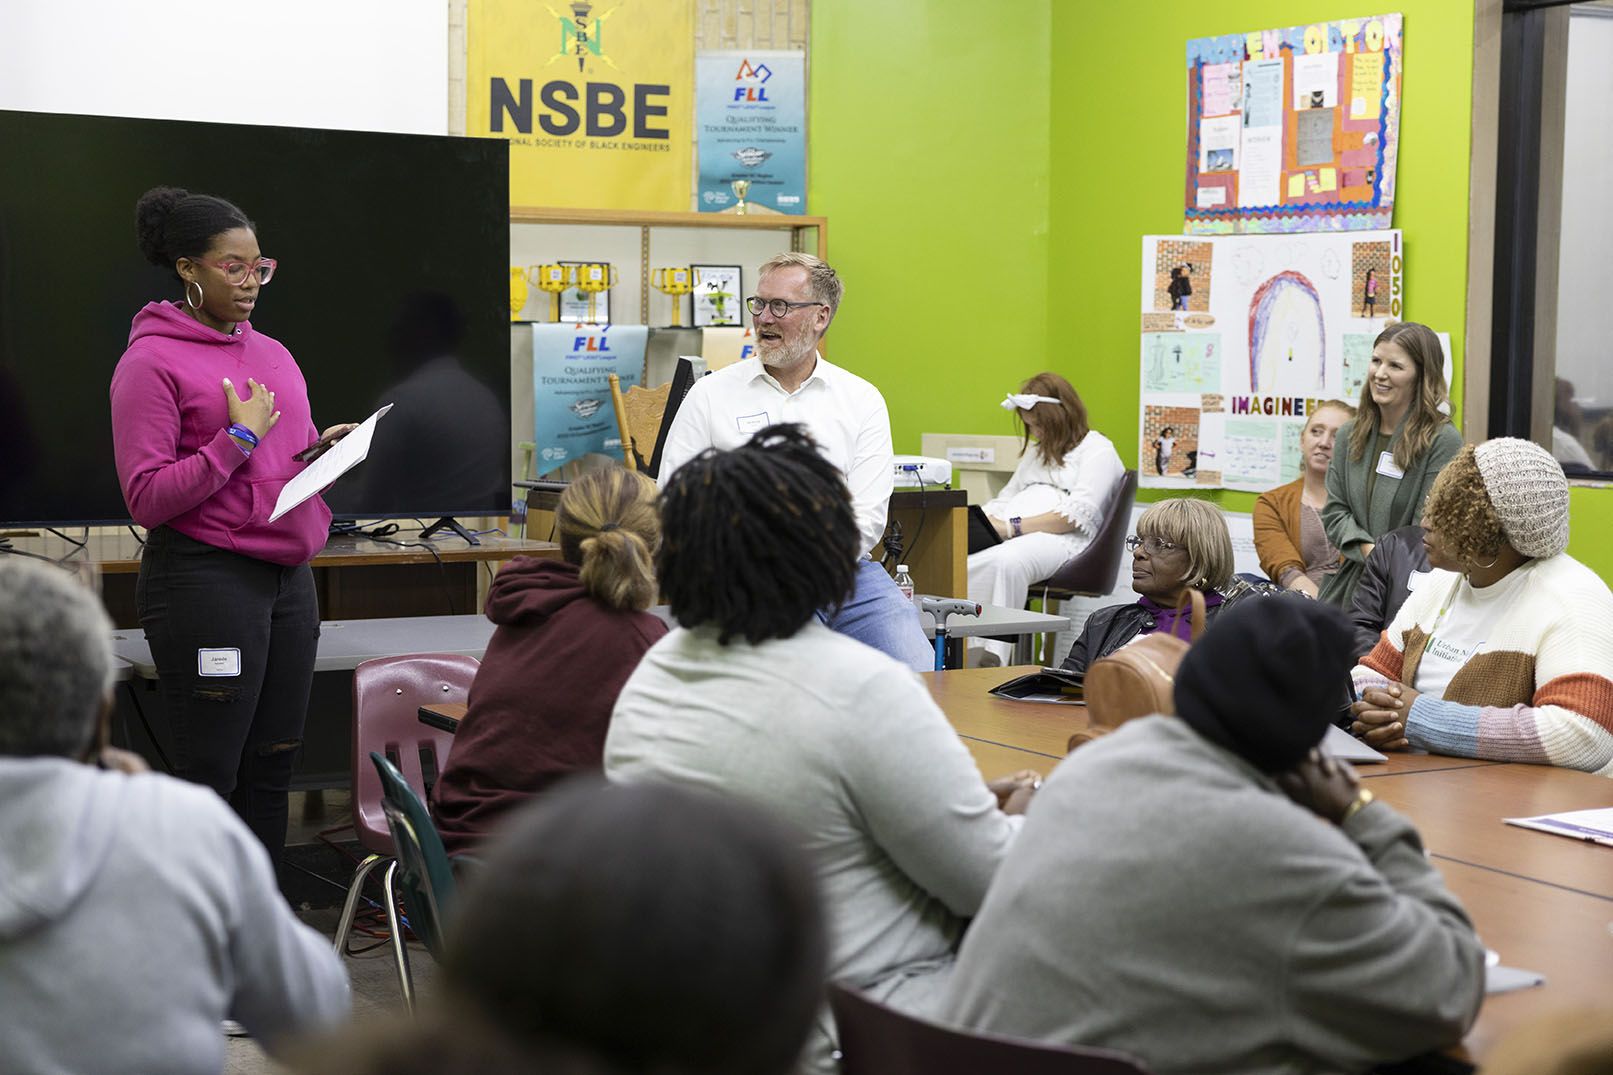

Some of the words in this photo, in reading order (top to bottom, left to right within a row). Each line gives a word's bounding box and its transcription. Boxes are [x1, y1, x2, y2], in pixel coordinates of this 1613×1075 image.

[734, 87, 769, 102] FLL
[490, 77, 671, 139] NSBE
[535, 139, 573, 148] SOCIETY
[575, 140, 587, 149] OF
[590, 141, 618, 150] BLACK
[621, 142, 671, 152] ENGINEERS
[573, 336, 610, 352] FLL
[1232, 396, 1325, 417] IMAGINEE
[1437, 640, 1460, 655] Urban
